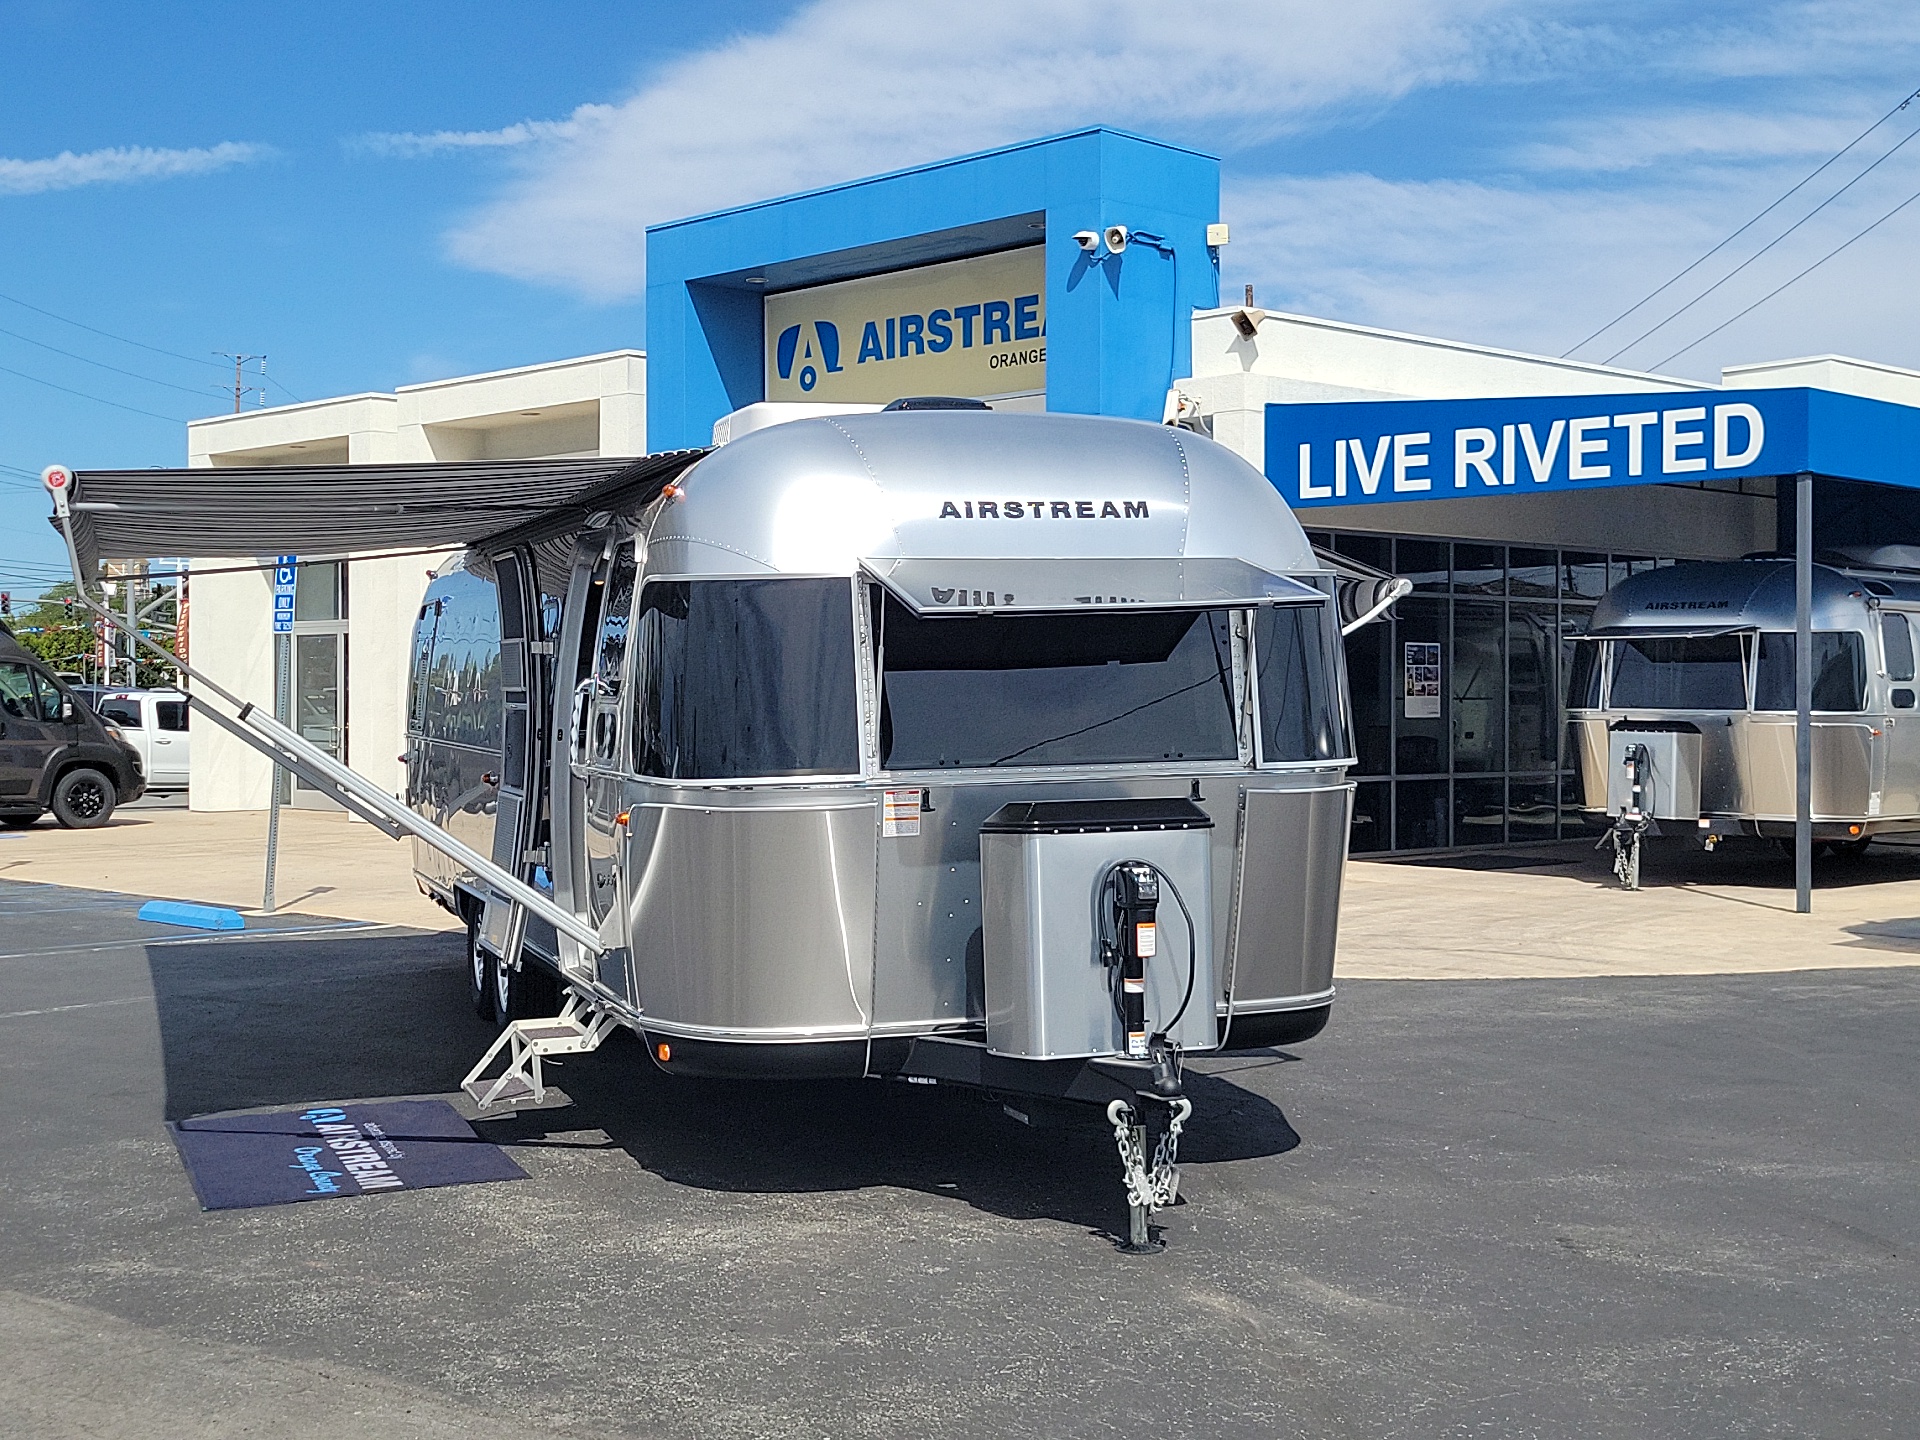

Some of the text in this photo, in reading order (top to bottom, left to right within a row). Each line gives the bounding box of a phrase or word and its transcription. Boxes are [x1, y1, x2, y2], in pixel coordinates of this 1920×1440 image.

[857, 294, 1046, 364] AIRSTRE
[989, 348, 1046, 369] ORANGE
[1299, 403, 1765, 499] LIVE RIVETED
[939, 500, 1150, 519] AIRSTREAM
[1645, 601, 1729, 610] AIRSTREAM
[315, 1124, 404, 1190] AIRSTREAM
